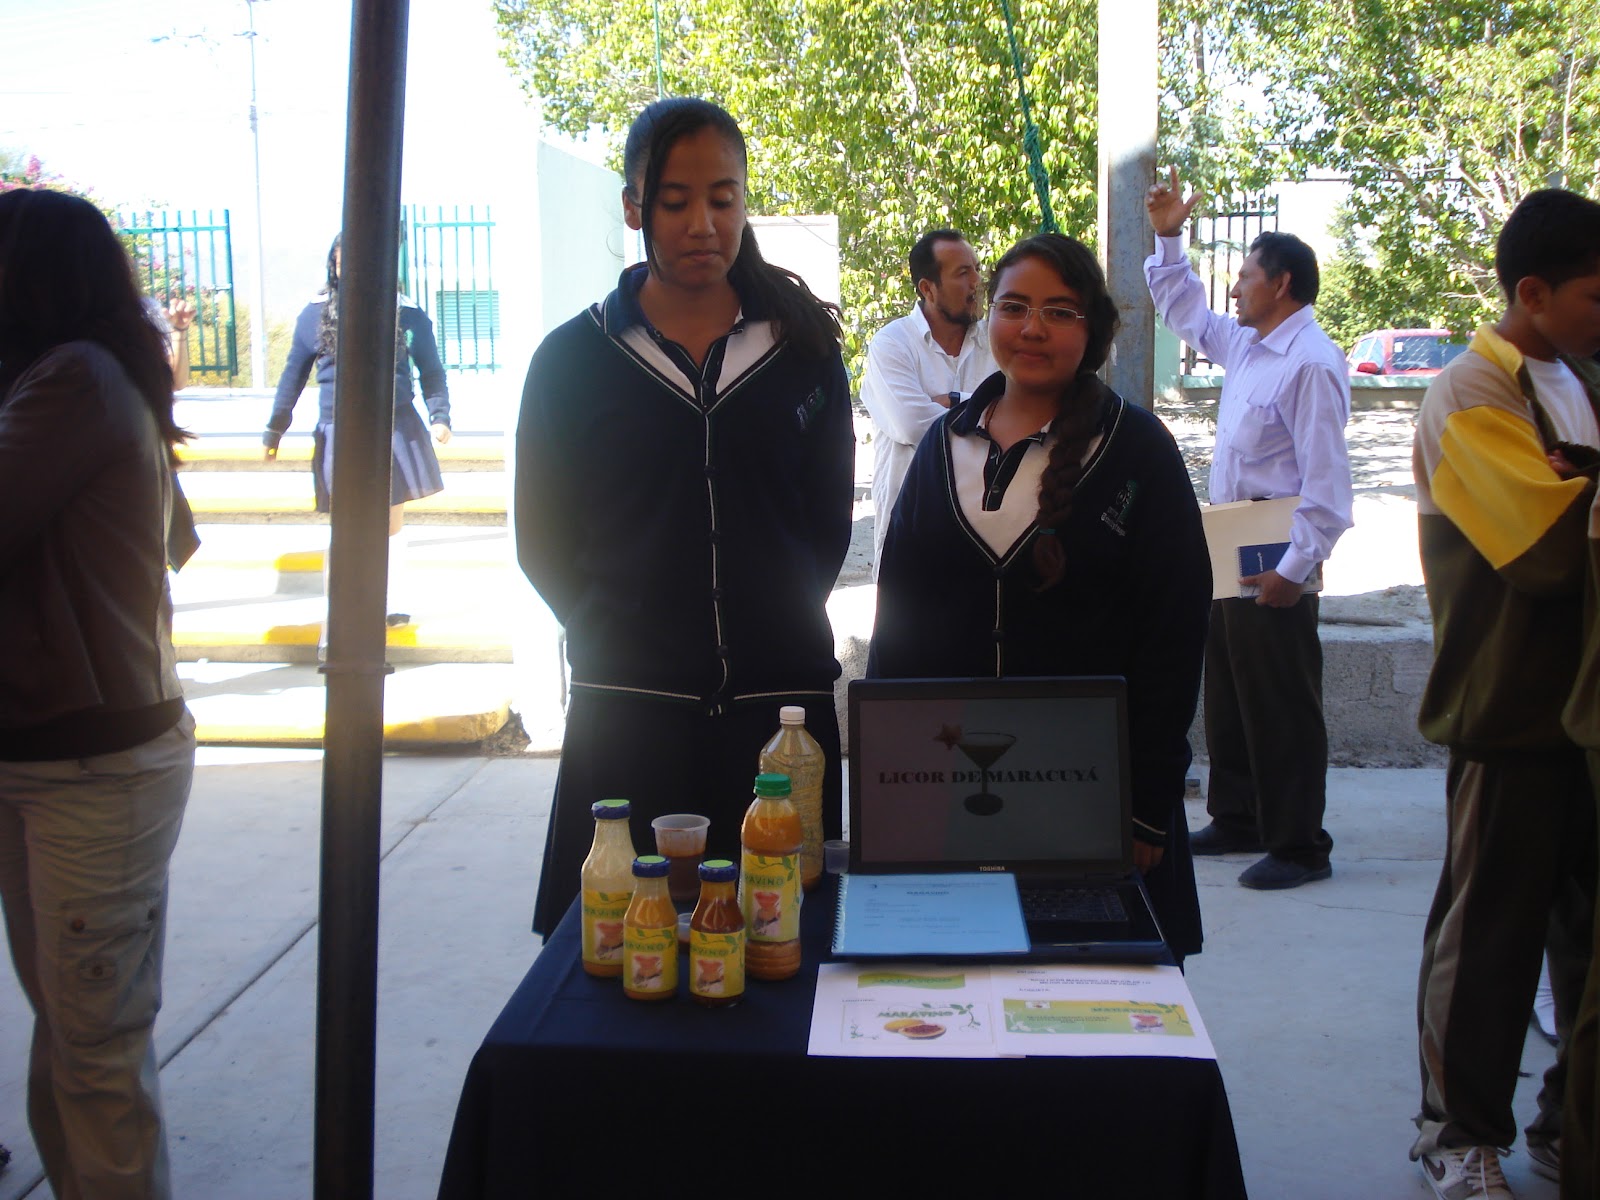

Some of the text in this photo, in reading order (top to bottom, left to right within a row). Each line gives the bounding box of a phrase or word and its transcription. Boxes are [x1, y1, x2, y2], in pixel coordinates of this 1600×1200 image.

[879, 766, 1099, 784] LICOR DE MARACUYÁ
[876, 1010, 954, 1019] MARAVINO
